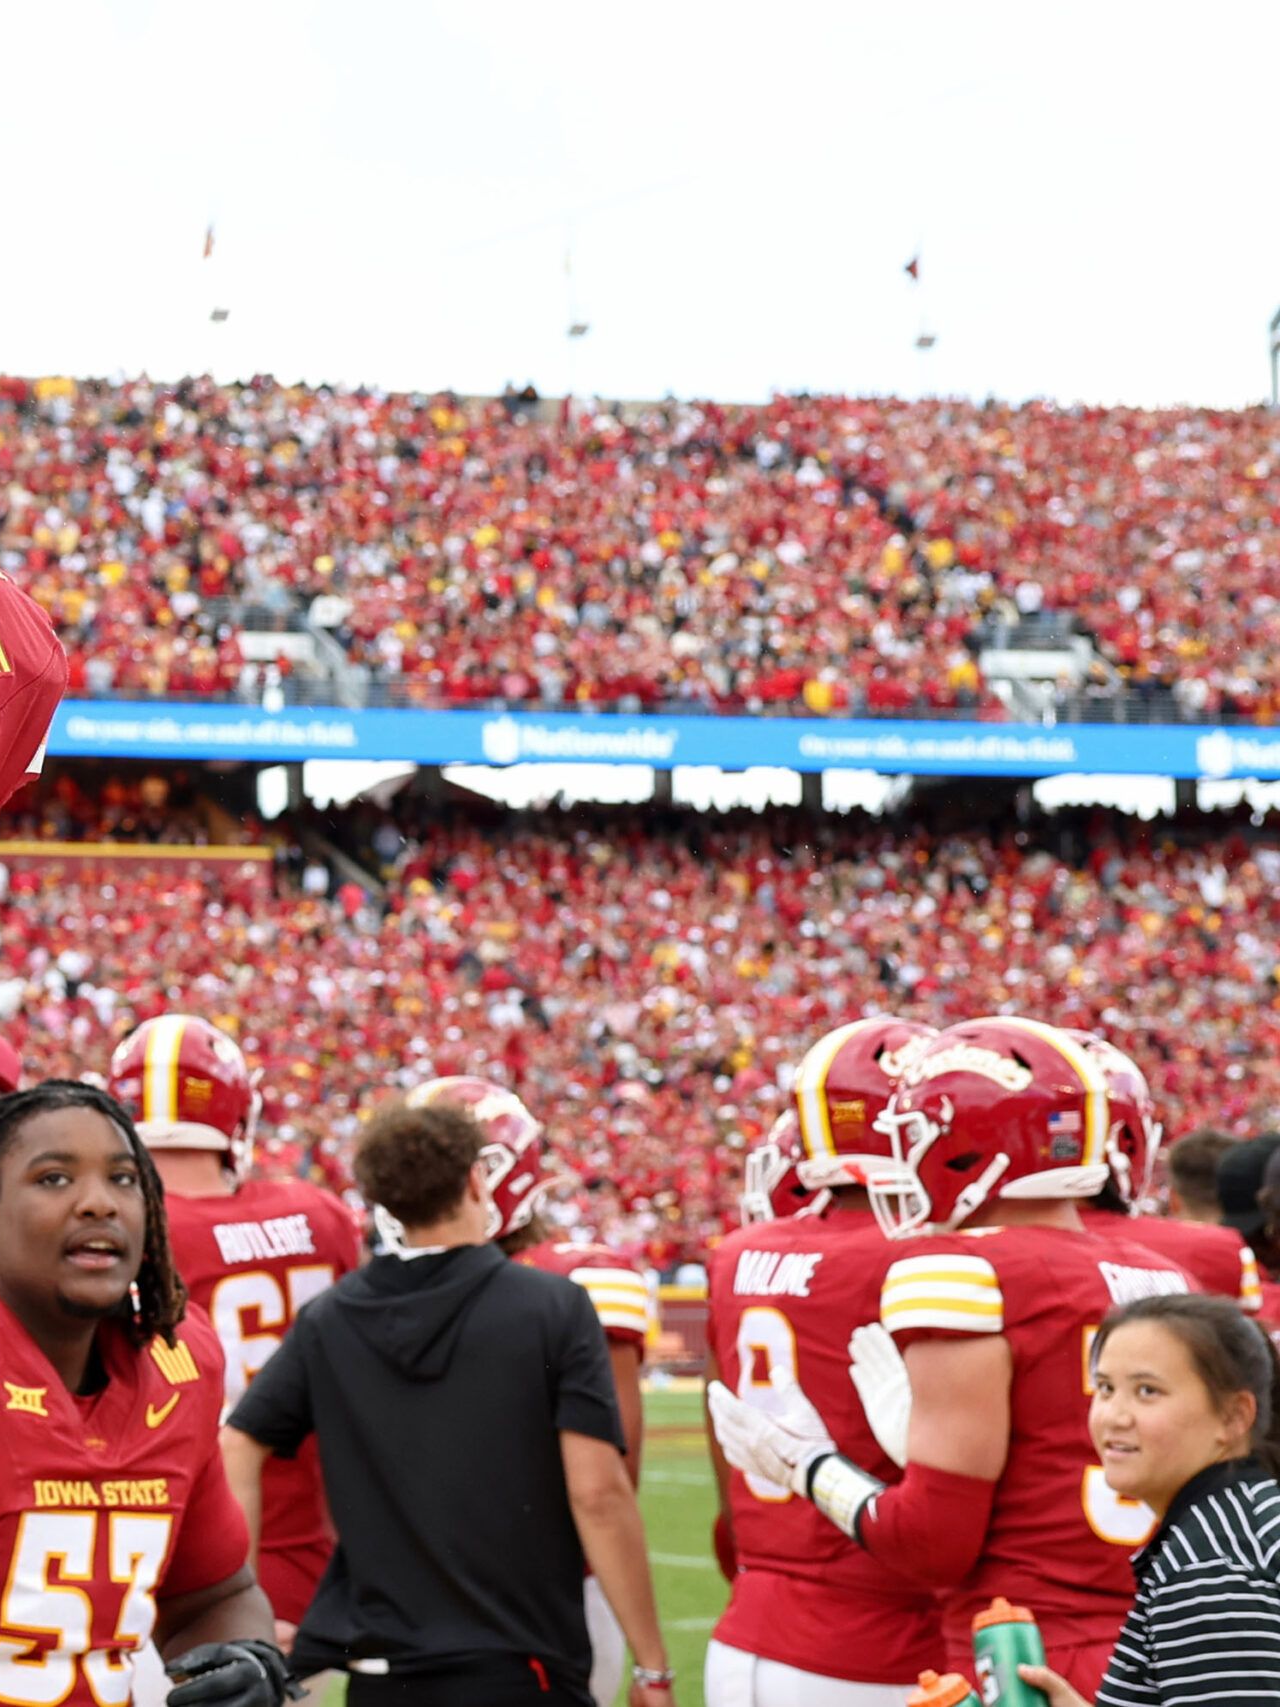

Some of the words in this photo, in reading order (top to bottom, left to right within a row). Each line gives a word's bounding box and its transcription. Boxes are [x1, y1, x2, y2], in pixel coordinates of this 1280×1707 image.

[3, 1381, 49, 1417] XII
[33, 1479, 100, 1506] IOWA
[101, 1478, 169, 1506] STATE
